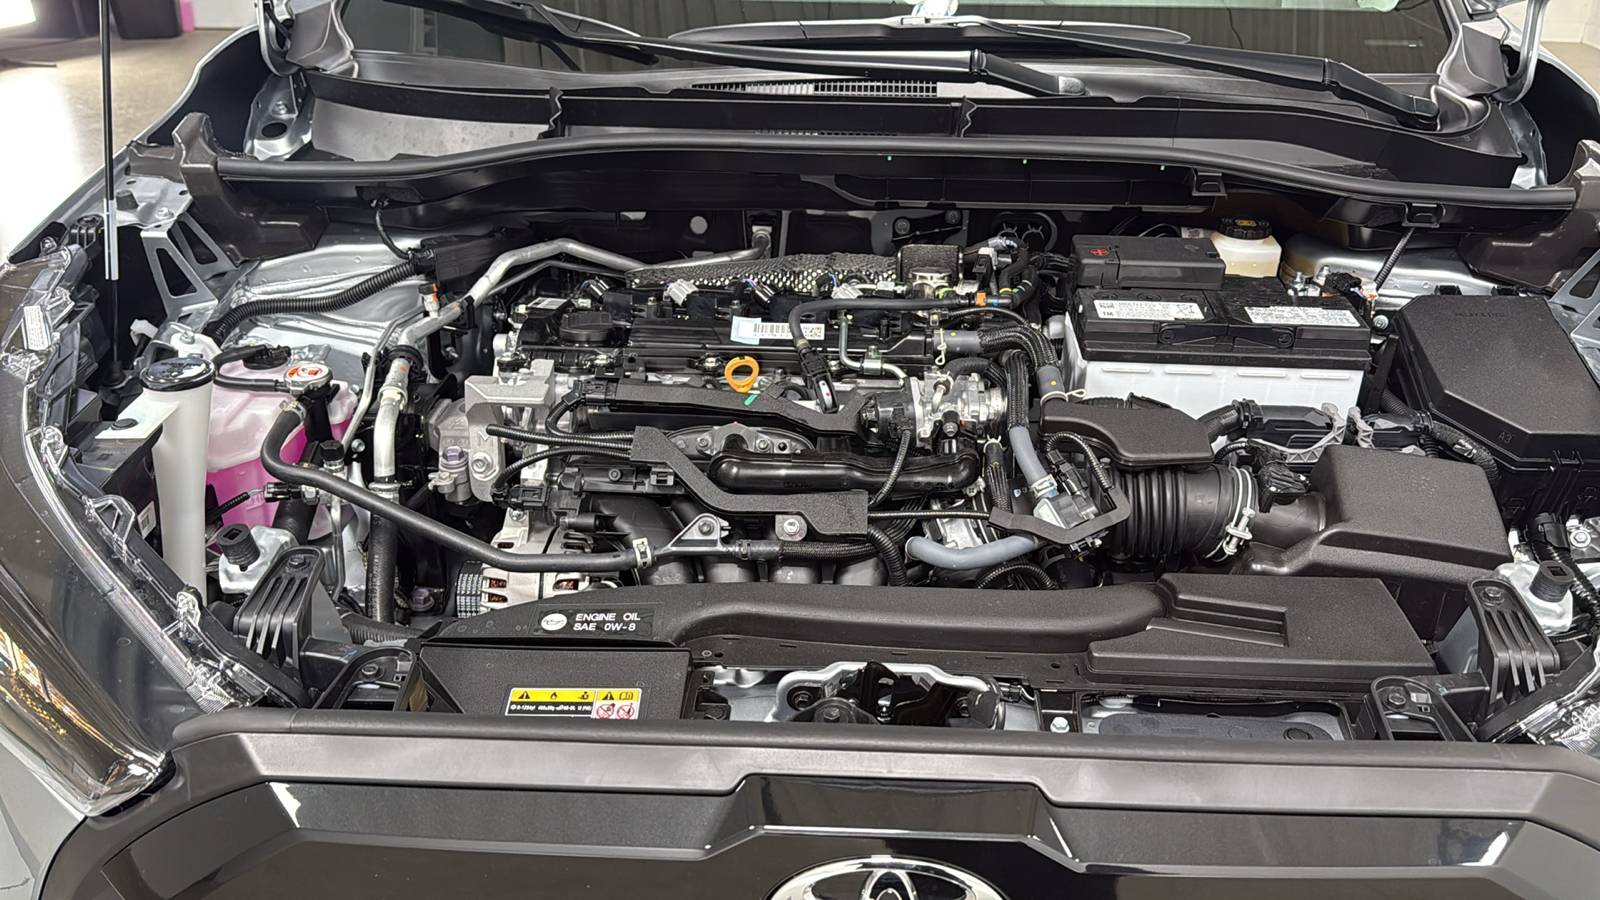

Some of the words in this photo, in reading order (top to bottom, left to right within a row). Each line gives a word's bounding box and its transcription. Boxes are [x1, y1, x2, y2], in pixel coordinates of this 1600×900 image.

[1497, 431, 1512, 444] A3
[575, 613, 616, 621] ENGINE
[623, 612, 641, 621] OIL
[573, 622, 597, 631] SAE
[604, 622, 636, 631] 0W-8
